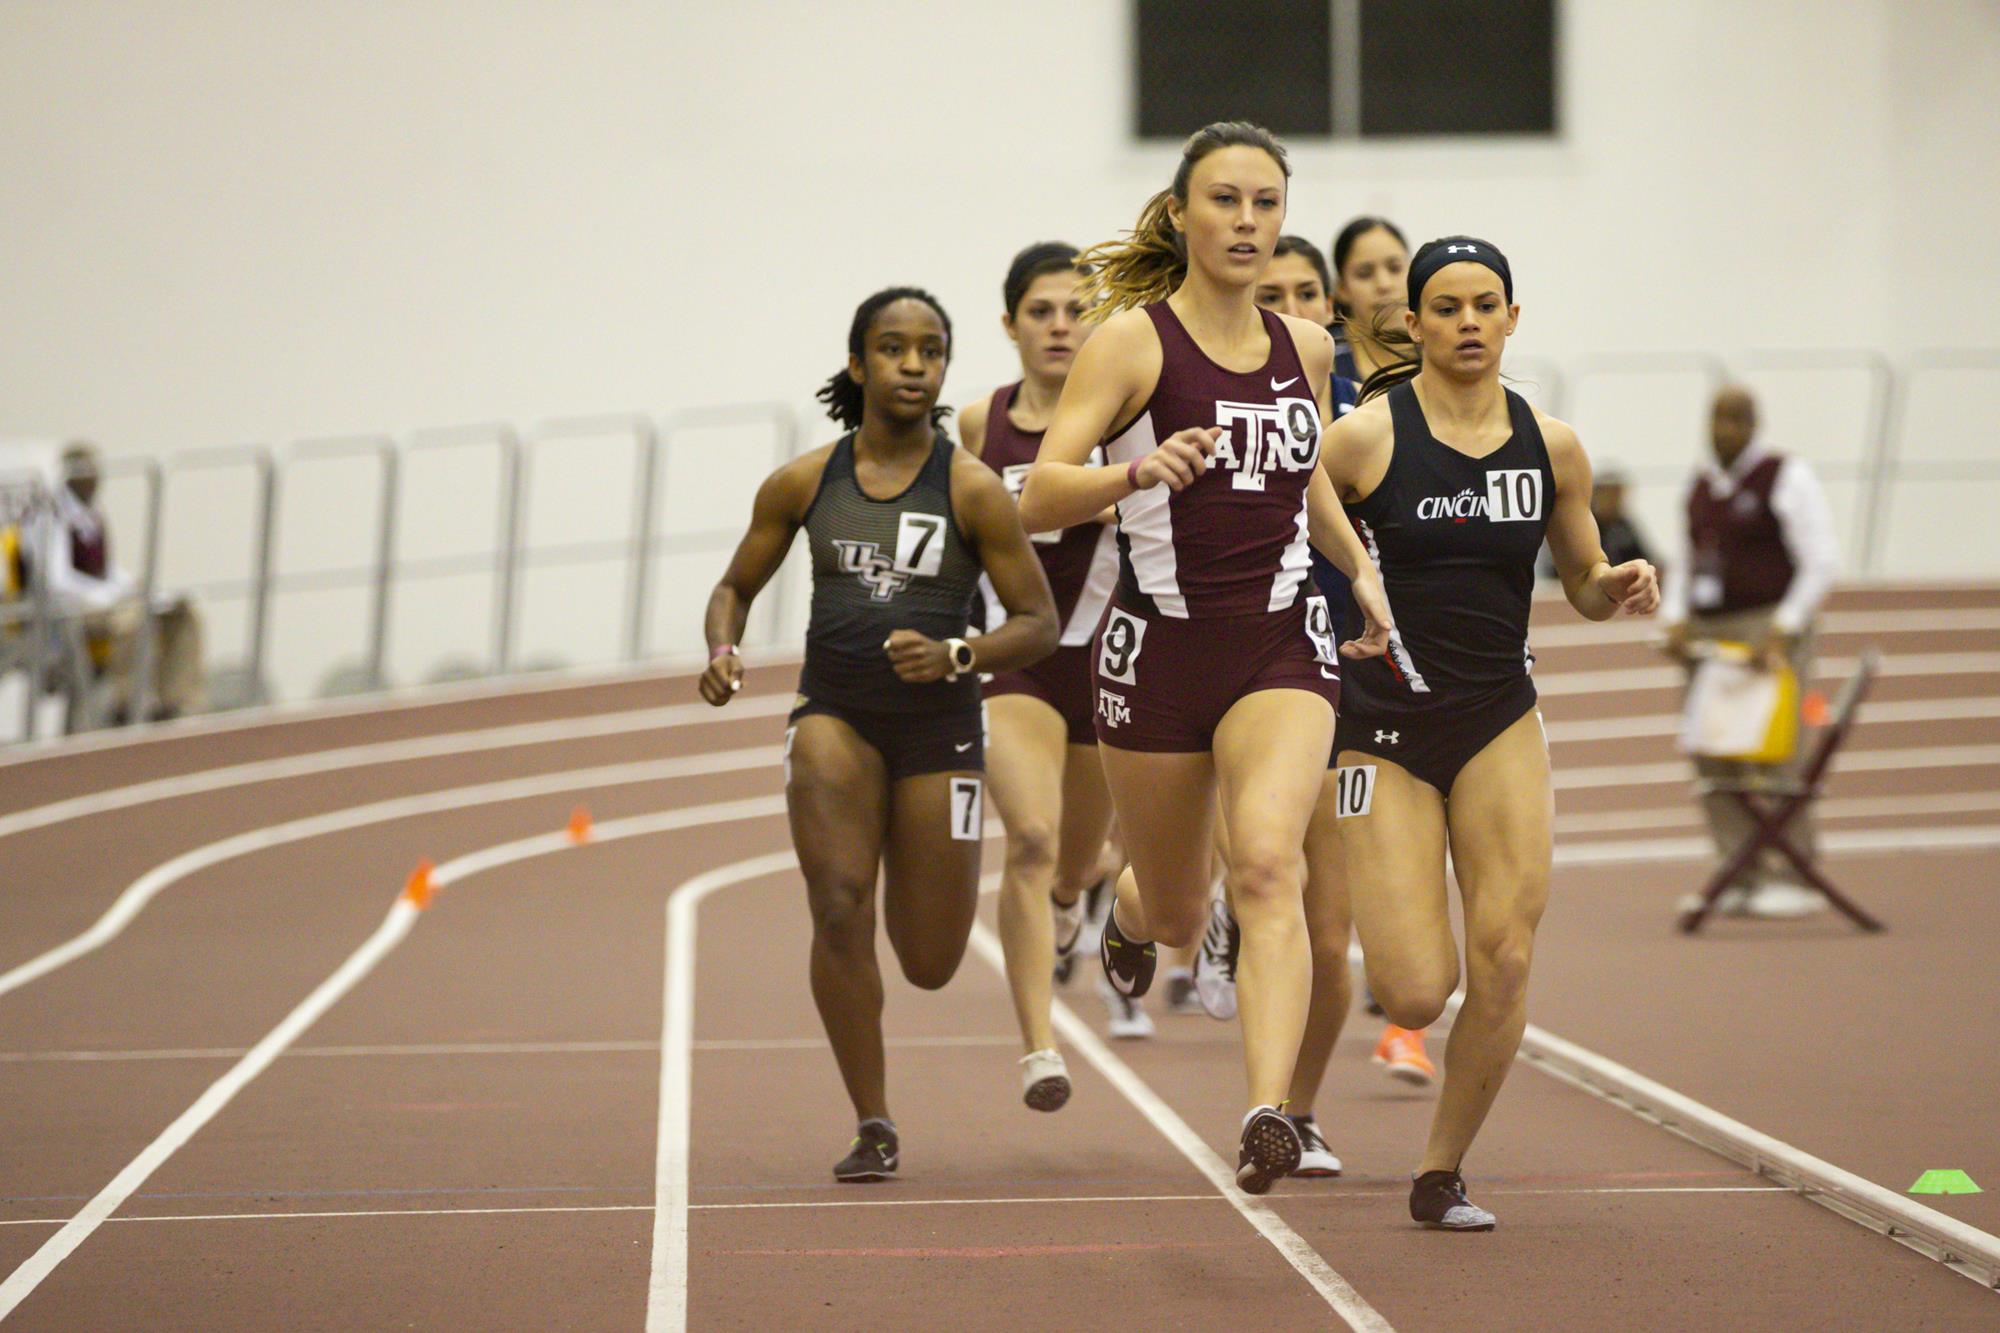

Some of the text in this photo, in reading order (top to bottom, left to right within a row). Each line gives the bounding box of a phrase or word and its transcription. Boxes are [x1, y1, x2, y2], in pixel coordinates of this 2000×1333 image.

[1287, 402, 1317, 463] 9
[1492, 472, 1536, 519] 10
[907, 519, 938, 569] 7
[832, 540, 913, 602] UCF
[1105, 616, 1137, 677] 9
[957, 784, 977, 834] 7
[1338, 768, 1367, 815] 10
